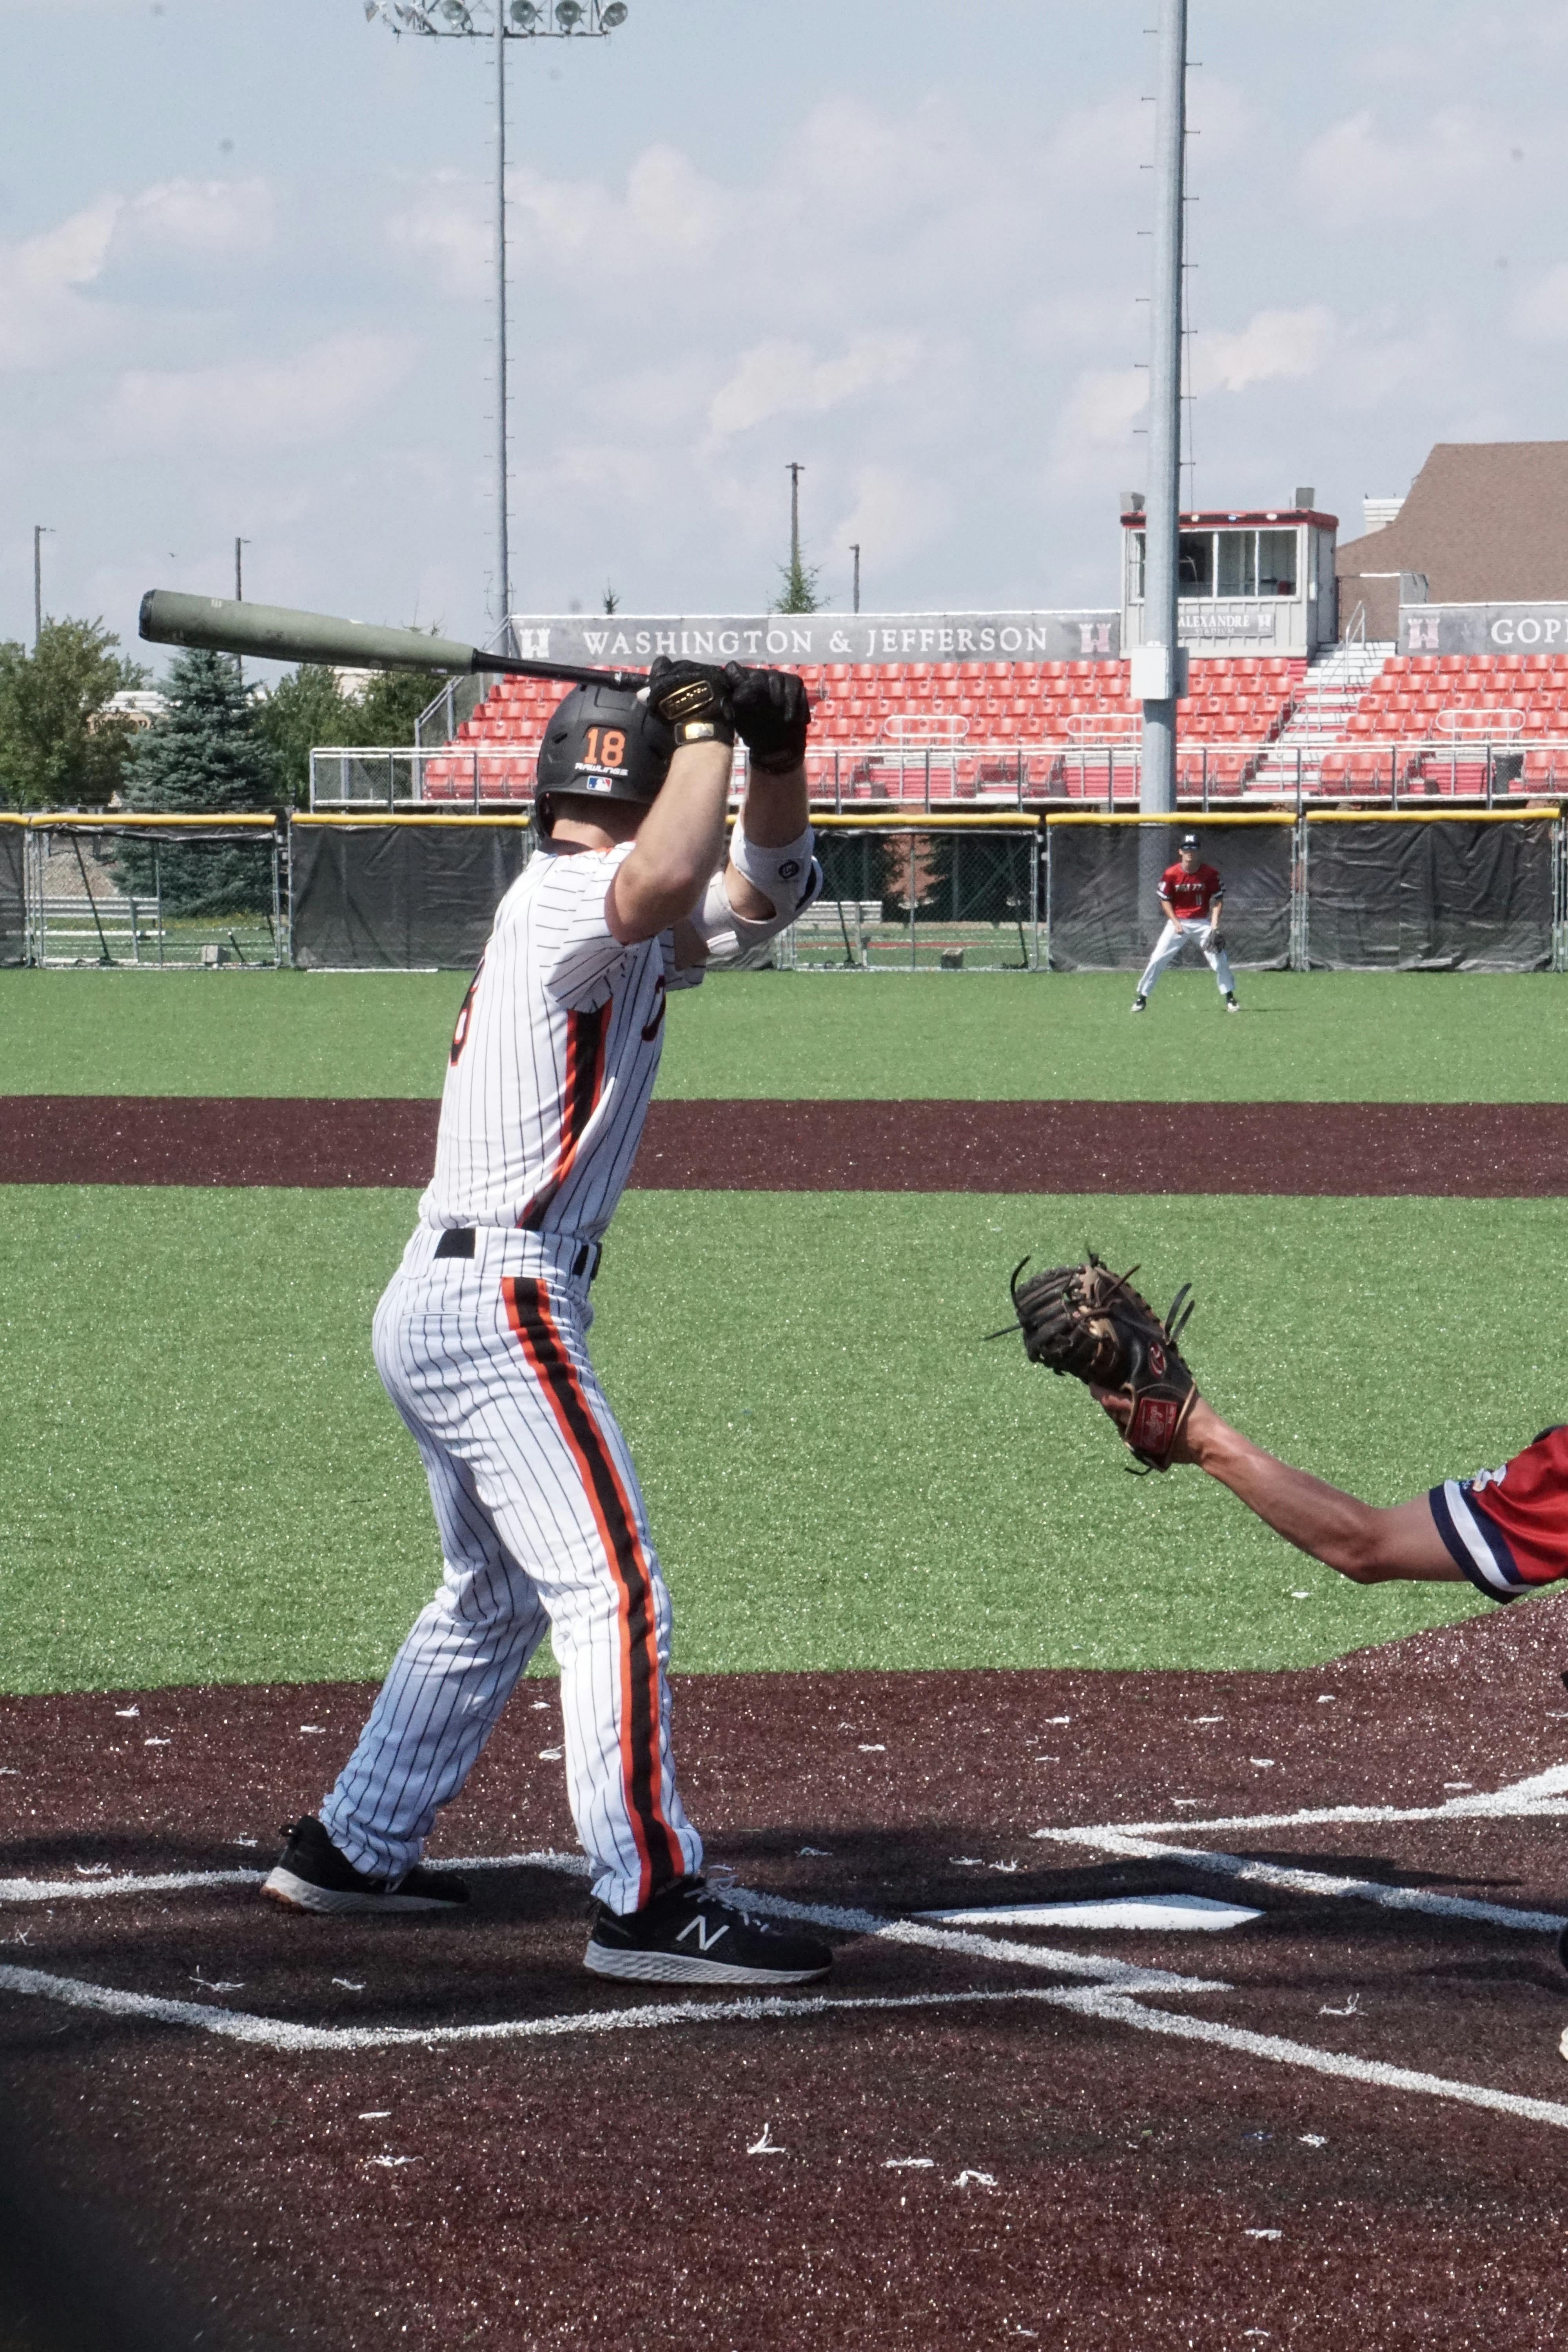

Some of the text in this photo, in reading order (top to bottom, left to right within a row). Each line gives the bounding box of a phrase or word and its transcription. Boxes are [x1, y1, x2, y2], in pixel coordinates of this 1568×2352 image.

[1178, 614, 1250, 628] ALEXANDRE
[1491, 618, 1568, 644] GOP
[584, 626, 1047, 657] WASHINGTON & JEFFERSON
[584, 728, 626, 768] 18
[574, 762, 629, 777] RAWLINGS
[675, 1914, 730, 1951] N
